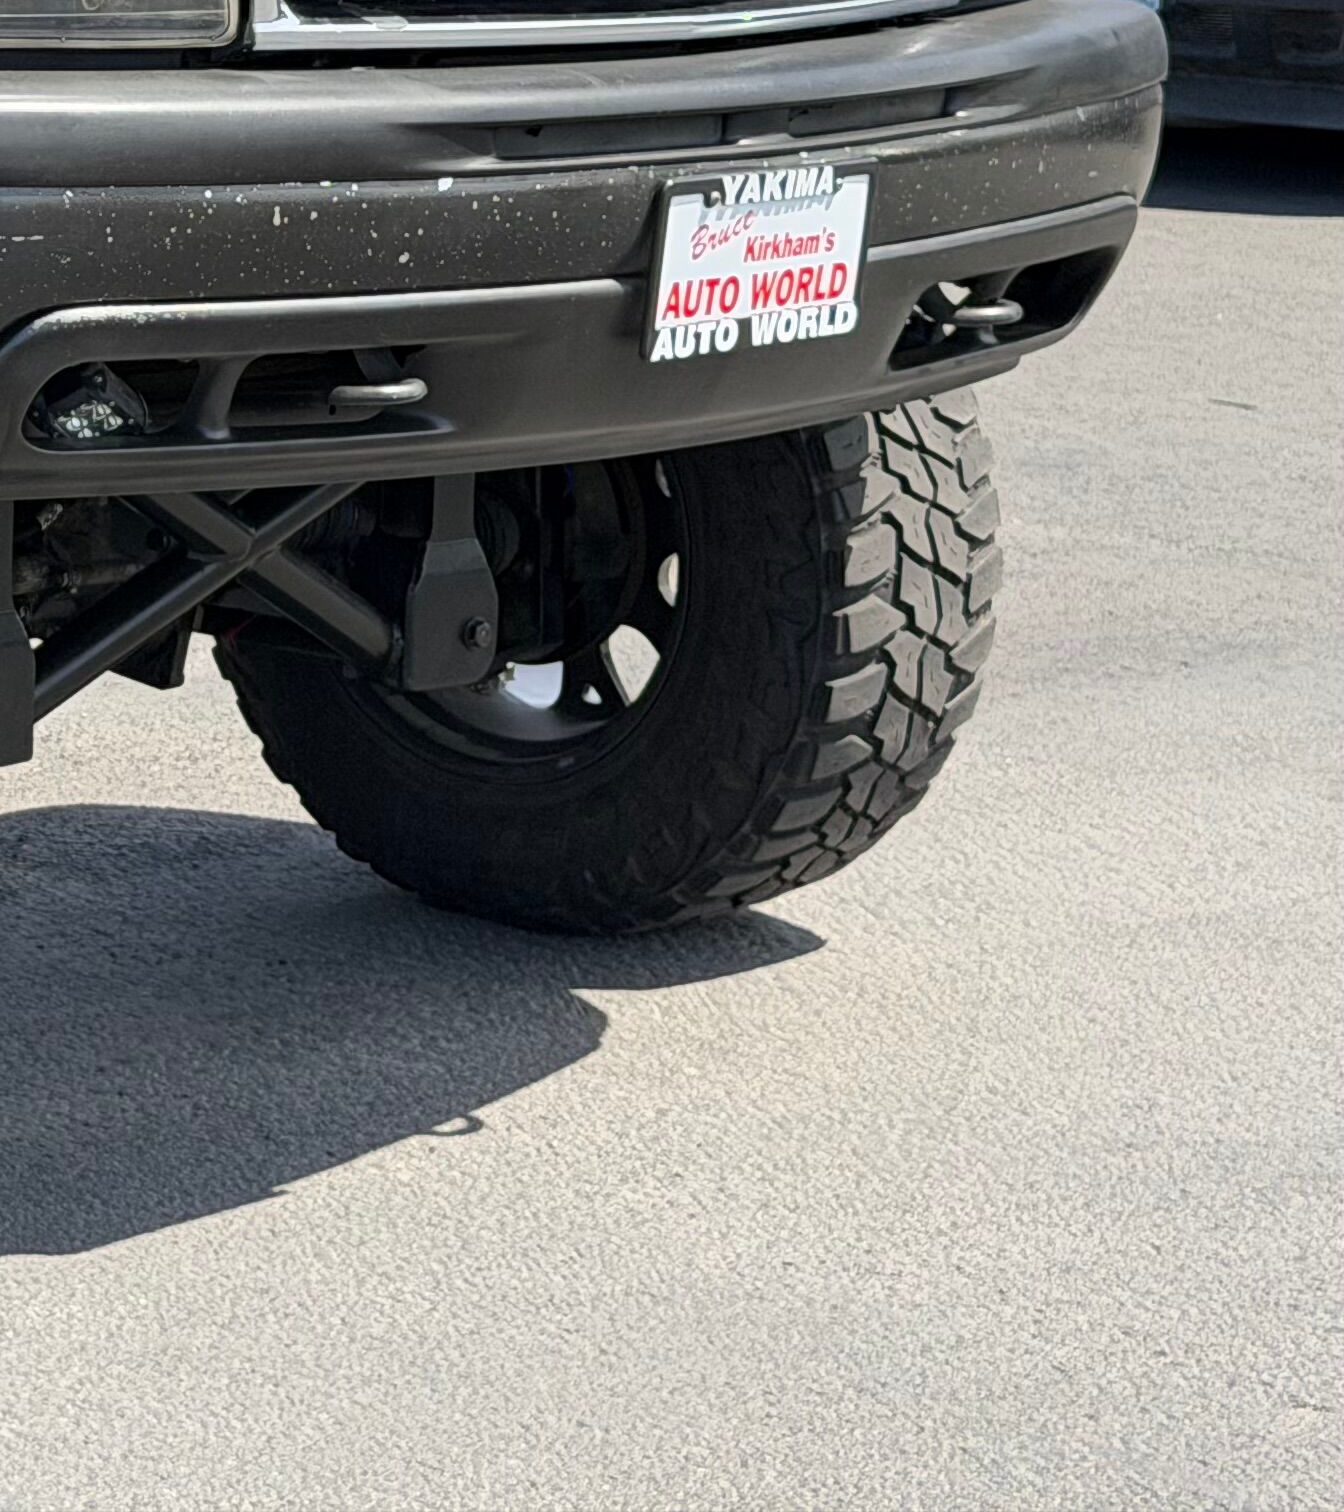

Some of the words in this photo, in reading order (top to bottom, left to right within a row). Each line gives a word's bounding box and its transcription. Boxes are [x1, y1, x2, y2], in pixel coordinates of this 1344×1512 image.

[721, 165, 835, 206] YAKIMA
[743, 227, 835, 263] Kirkham's
[661, 275, 740, 321] AUTO
[750, 262, 848, 310] WORLD
[649, 317, 739, 363] AUTO
[750, 302, 859, 347] WORLD
